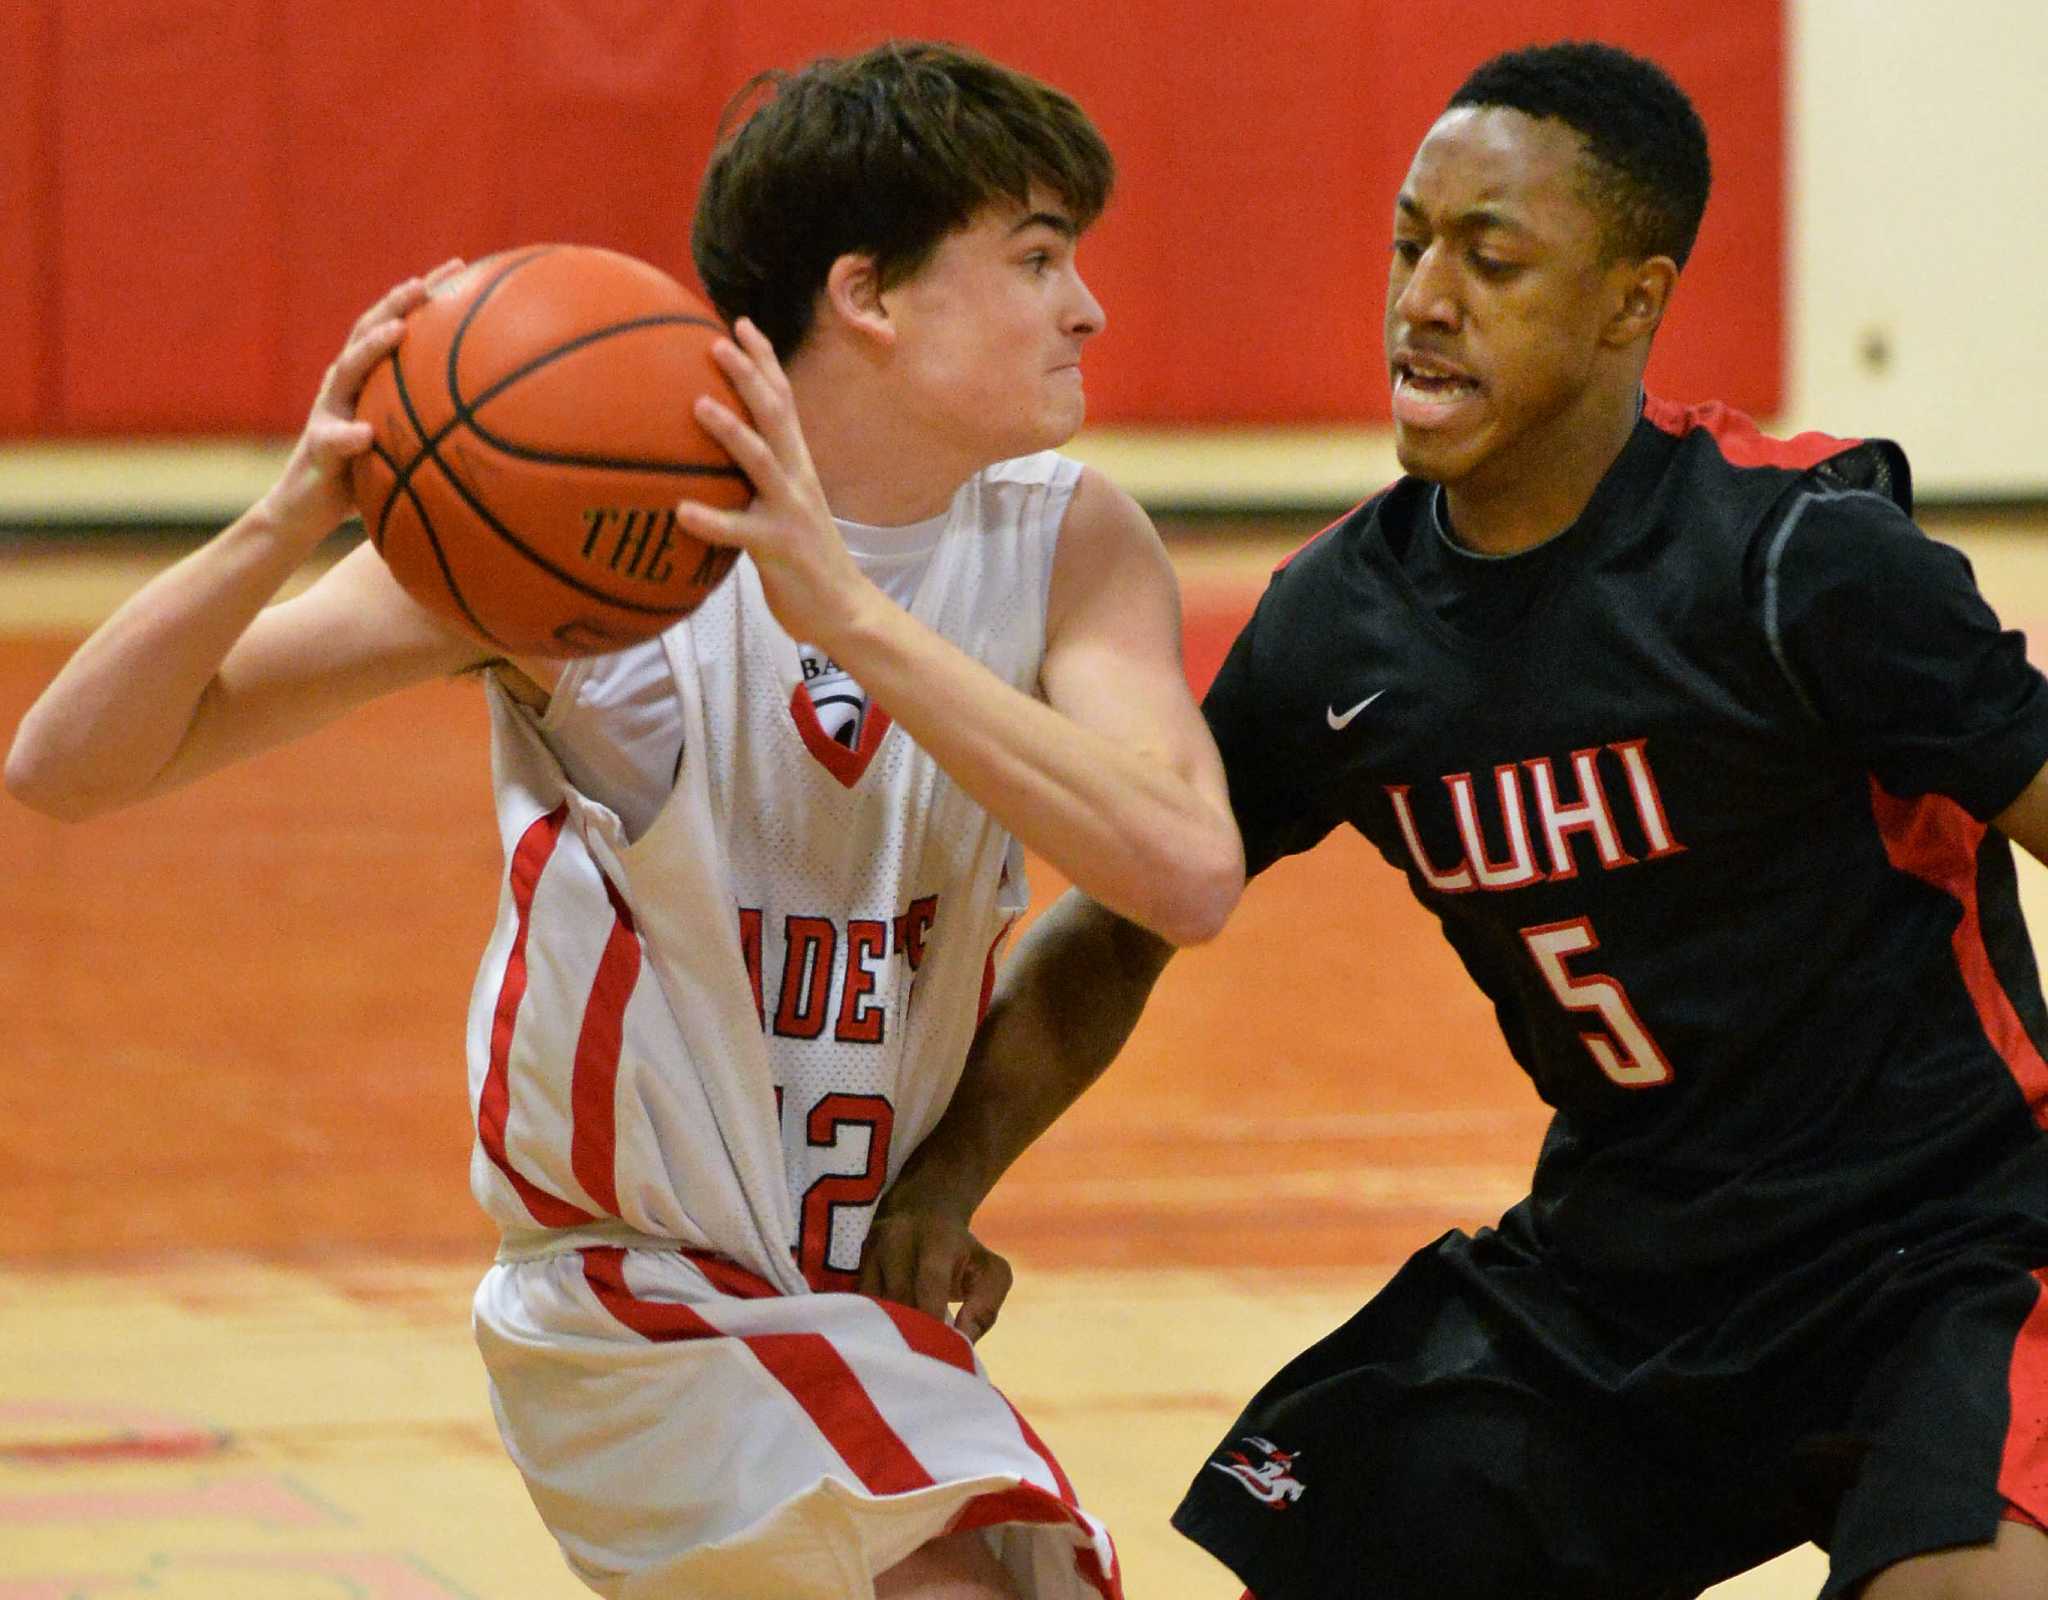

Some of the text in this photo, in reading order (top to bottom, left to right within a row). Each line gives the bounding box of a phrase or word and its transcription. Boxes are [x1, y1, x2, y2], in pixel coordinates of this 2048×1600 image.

[582, 507, 680, 584] THE
[1384, 737, 1689, 894] LUHI
[1520, 915, 1676, 1090] 5
[774, 1085, 895, 1294] 2
